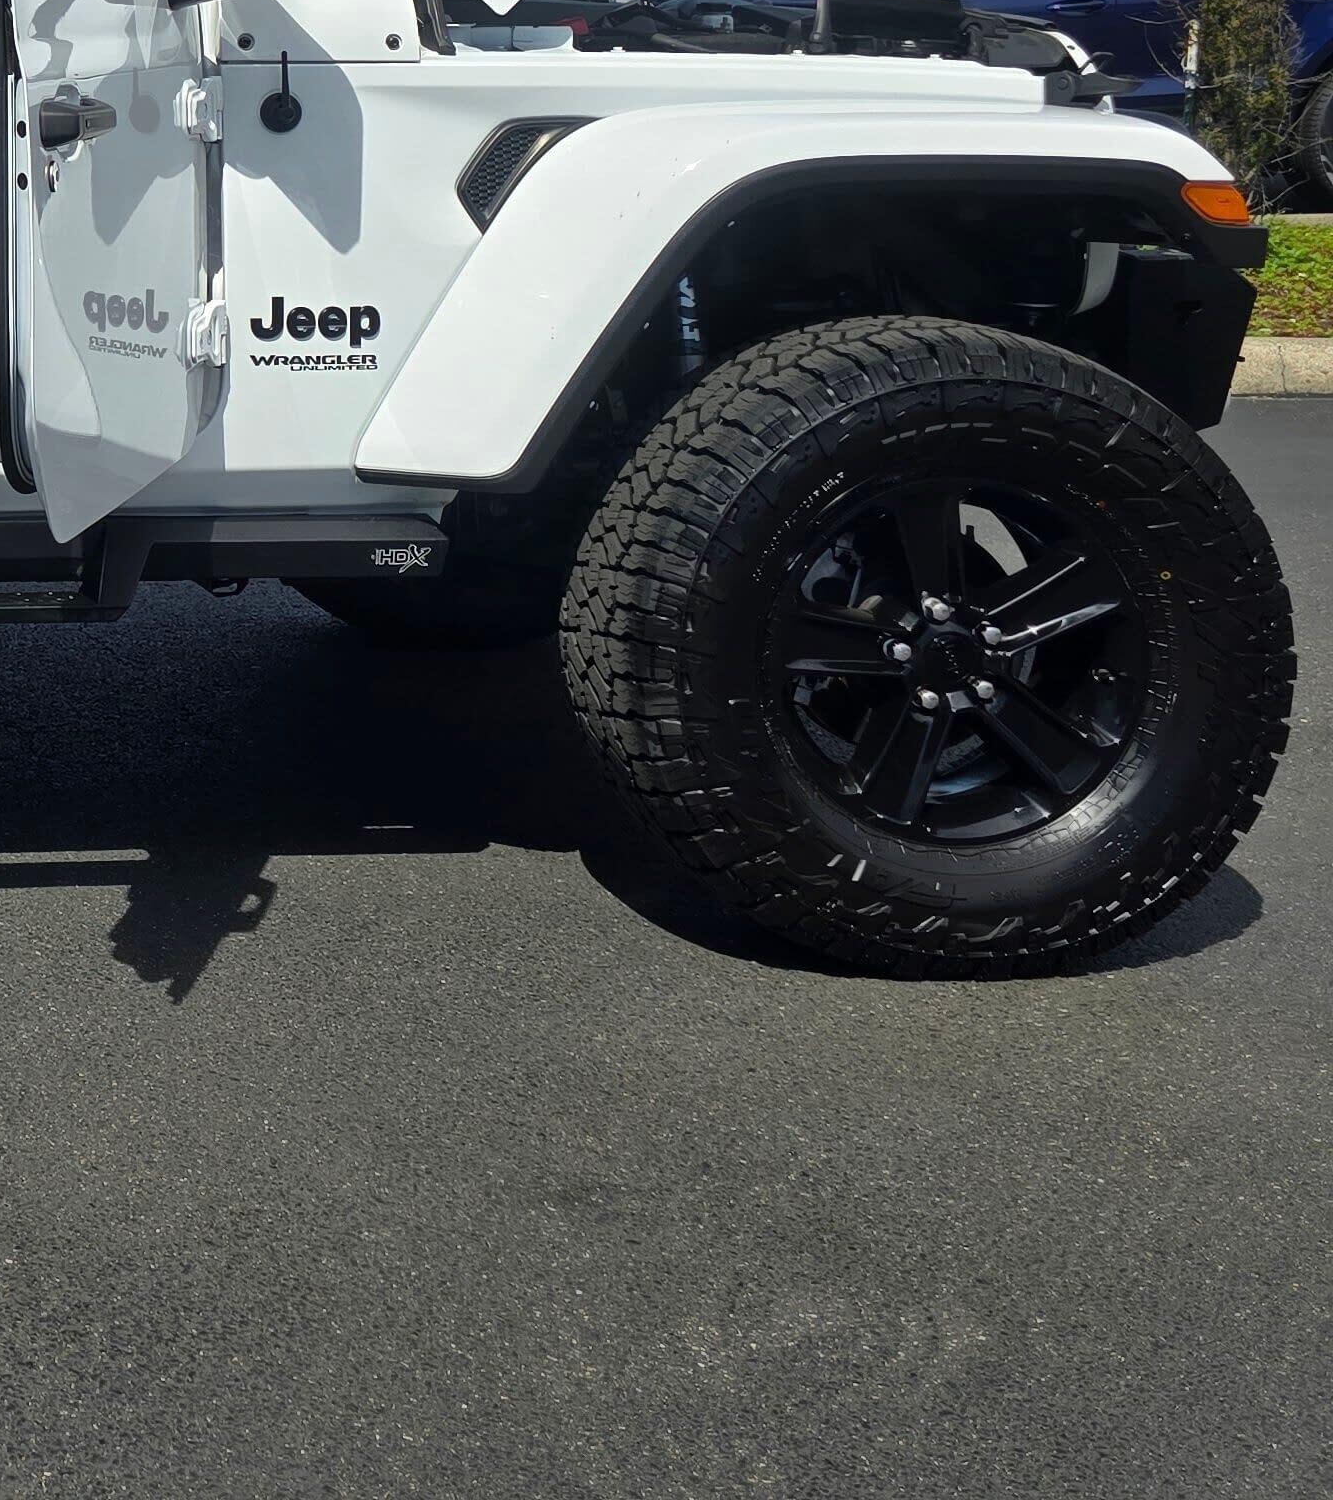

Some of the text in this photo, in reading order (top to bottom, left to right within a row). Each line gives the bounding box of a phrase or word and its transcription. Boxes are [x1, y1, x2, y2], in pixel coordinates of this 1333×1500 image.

[249, 296, 381, 349] Jeep
[249, 354, 378, 367] WRANGLER
[290, 364, 379, 372] UNLIMITED
[377, 543, 432, 574] HDX
